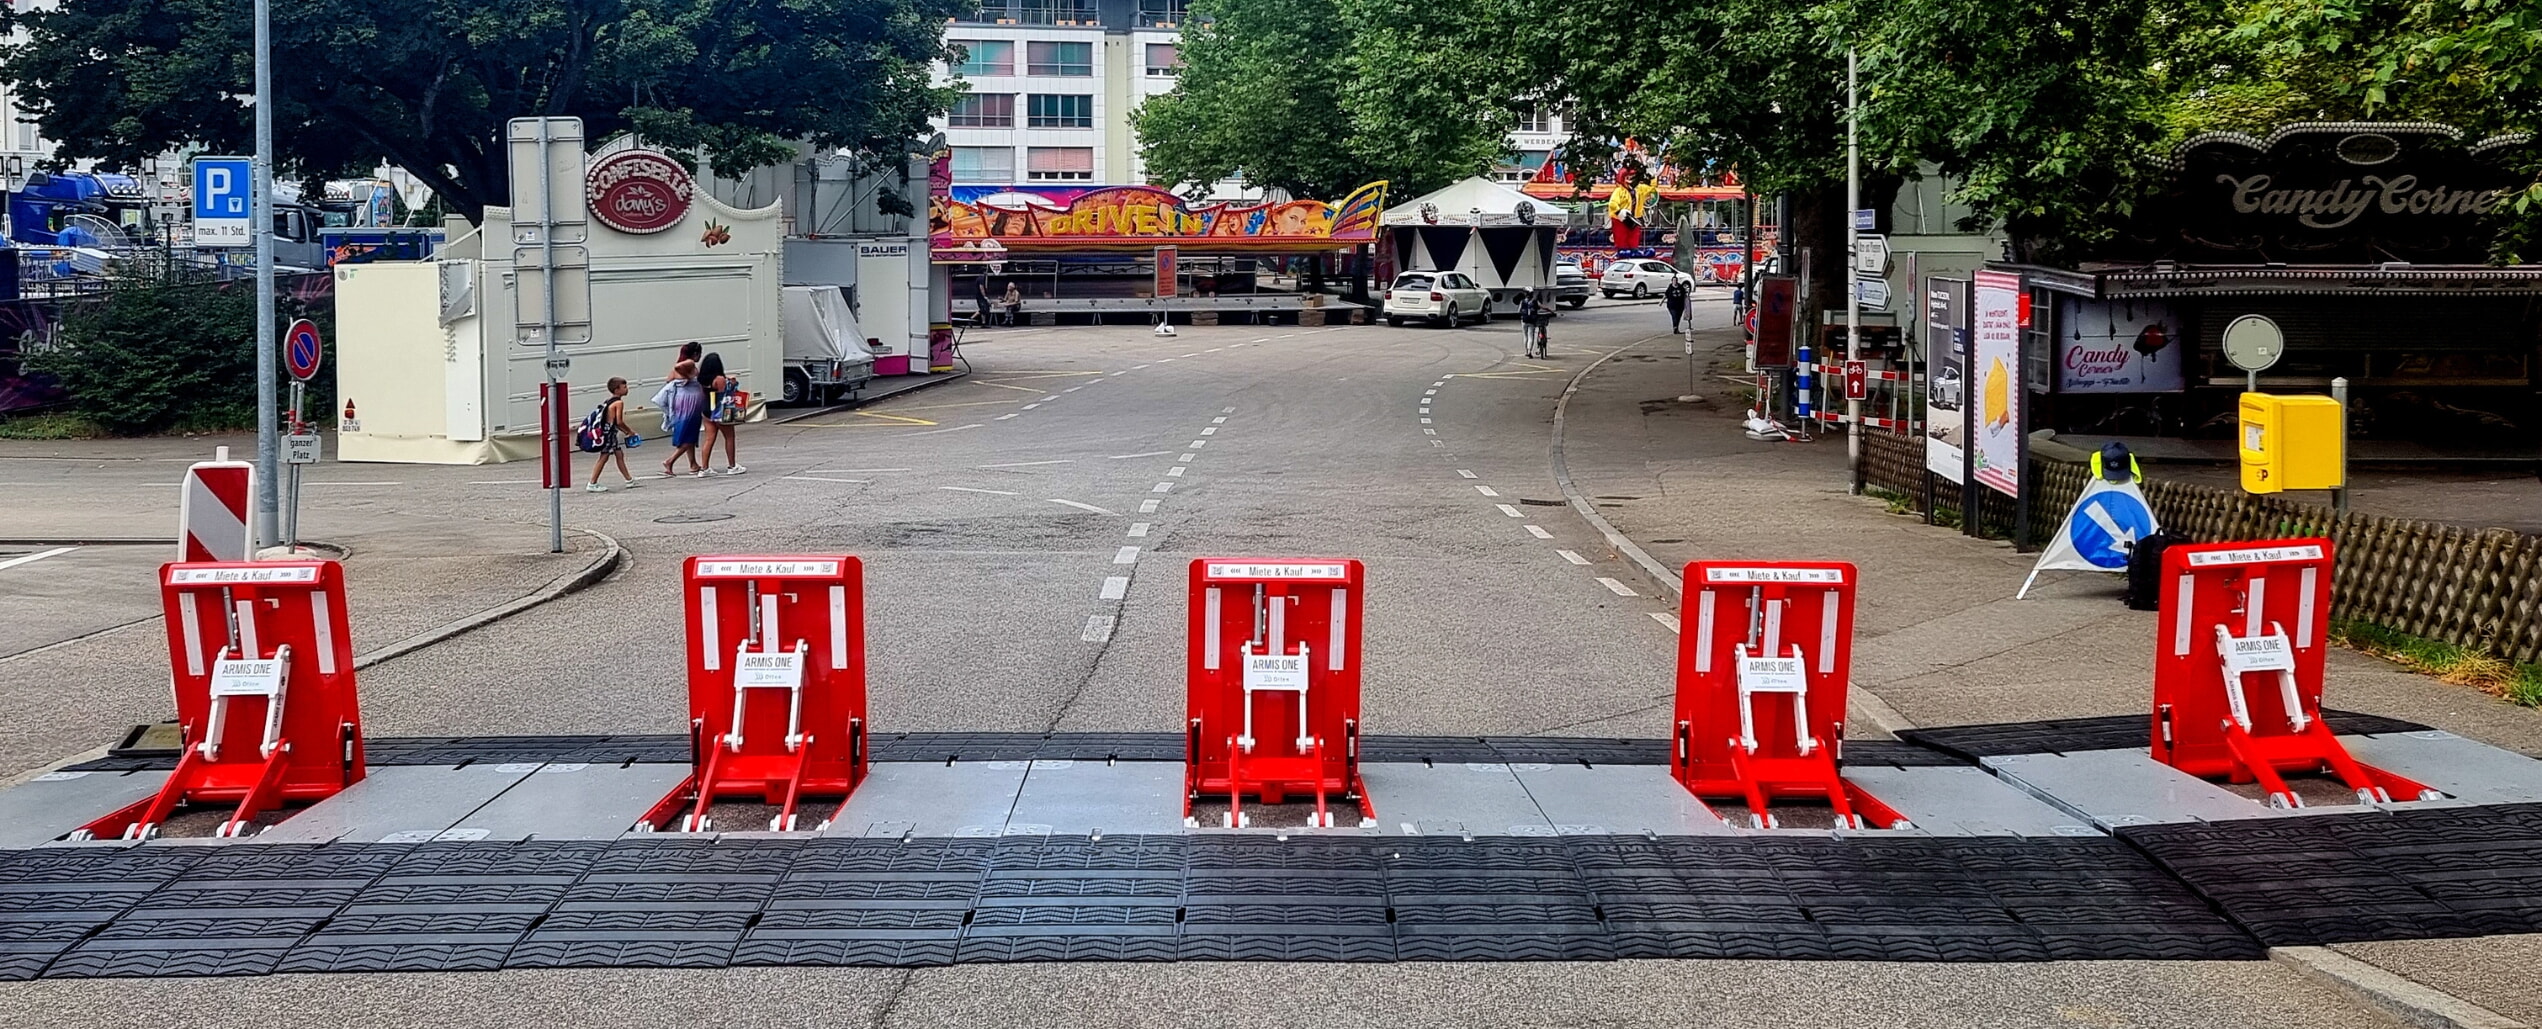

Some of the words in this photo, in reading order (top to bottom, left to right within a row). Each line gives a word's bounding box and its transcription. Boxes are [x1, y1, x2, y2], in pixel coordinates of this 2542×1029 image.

[591, 159, 690, 202] CONFISERIE
[206, 168, 231, 210] P
[2216, 174, 2378, 229] Candy
[1050, 204, 1159, 235] DRIVE
[1167, 210, 1204, 233] IN
[198, 227, 218, 236] max.
[221, 225, 228, 236] 11
[231, 225, 246, 236] Std.
[2065, 343, 2130, 371] Candy
[290, 440, 313, 449] ganzer
[293, 450, 310, 459] Platz
[2228, 551, 2251, 562] Miete
[2254, 552, 2261, 561] &
[2262, 550, 2281, 560] Kauf
[740, 563, 763, 574] Miete
[766, 565, 772, 573] &
[776, 563, 796, 574] Kauf
[1249, 566, 1272, 576] Miete
[1275, 567, 1281, 576] &
[1284, 566, 1304, 576] Kauf
[214, 571, 239, 581] Miete
[242, 572, 248, 581] &
[251, 570, 273, 580] Kauf
[1748, 570, 1770, 580] Miete
[1774, 571, 1779, 580] &
[1782, 570, 1801, 581] Kauf
[2235, 641, 2262, 652] ARMIS
[2263, 639, 2281, 651] ONE
[745, 657, 773, 668] ARMIS
[775, 657, 792, 668] ONE
[1253, 659, 1280, 670] ARMIS
[1282, 659, 1299, 670] ONE
[1750, 661, 1776, 672] ARMIS
[1778, 661, 1795, 672] ONE
[222, 664, 252, 675] ARMIS
[253, 663, 272, 674] ONE
